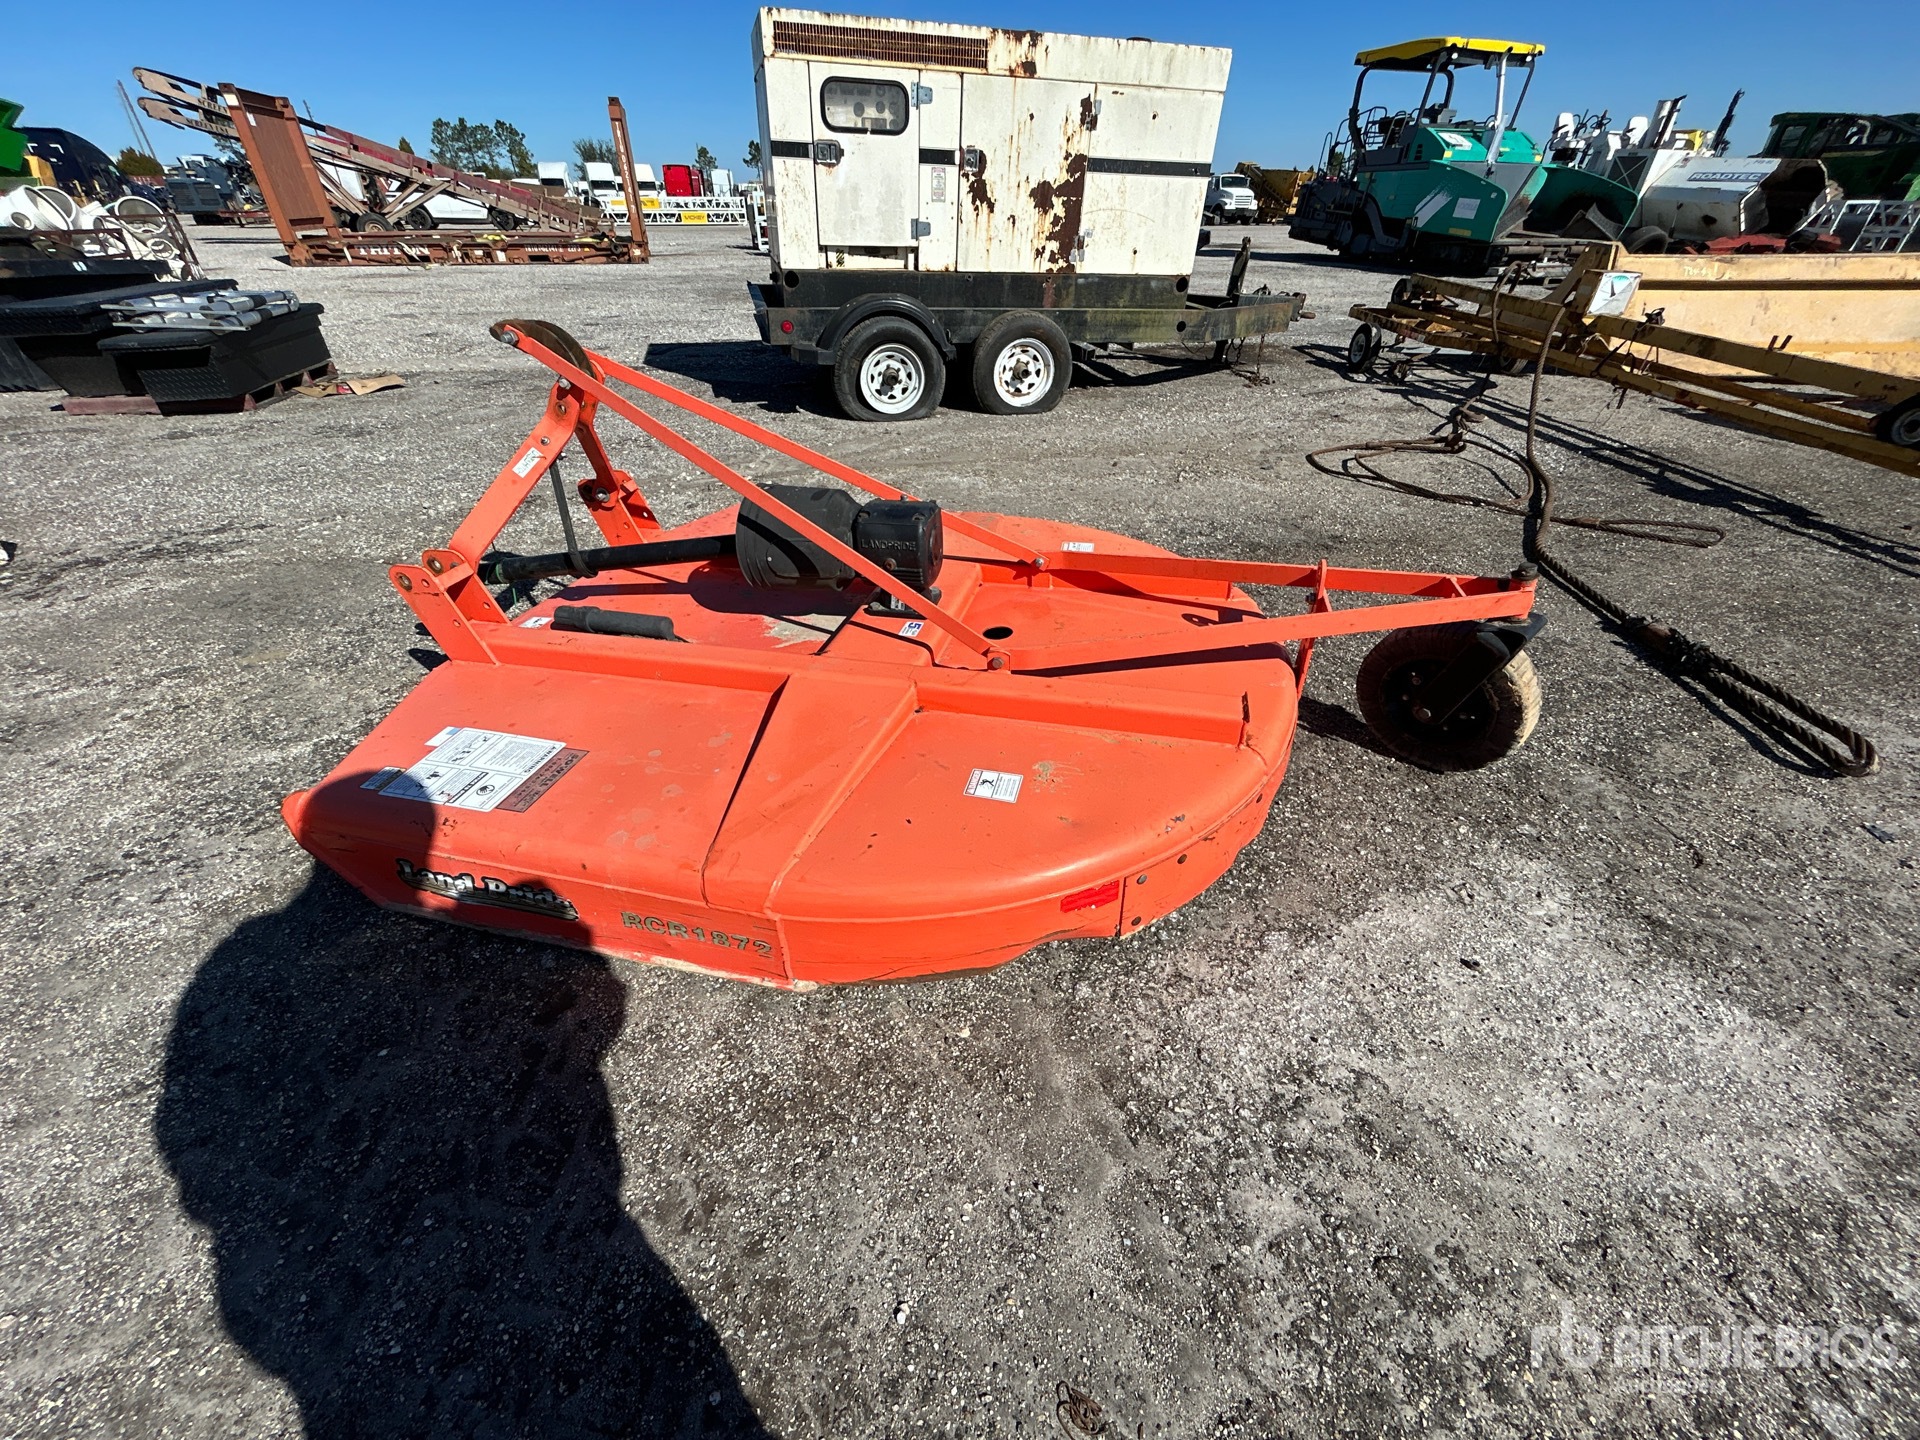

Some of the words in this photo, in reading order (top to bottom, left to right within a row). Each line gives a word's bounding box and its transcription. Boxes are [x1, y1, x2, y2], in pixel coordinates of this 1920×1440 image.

[1690, 172, 1760, 181] ROADTEC
[524, 750, 552, 773] WARNING
[397, 859, 475, 894] Land
[620, 911, 773, 959] RCR1872
